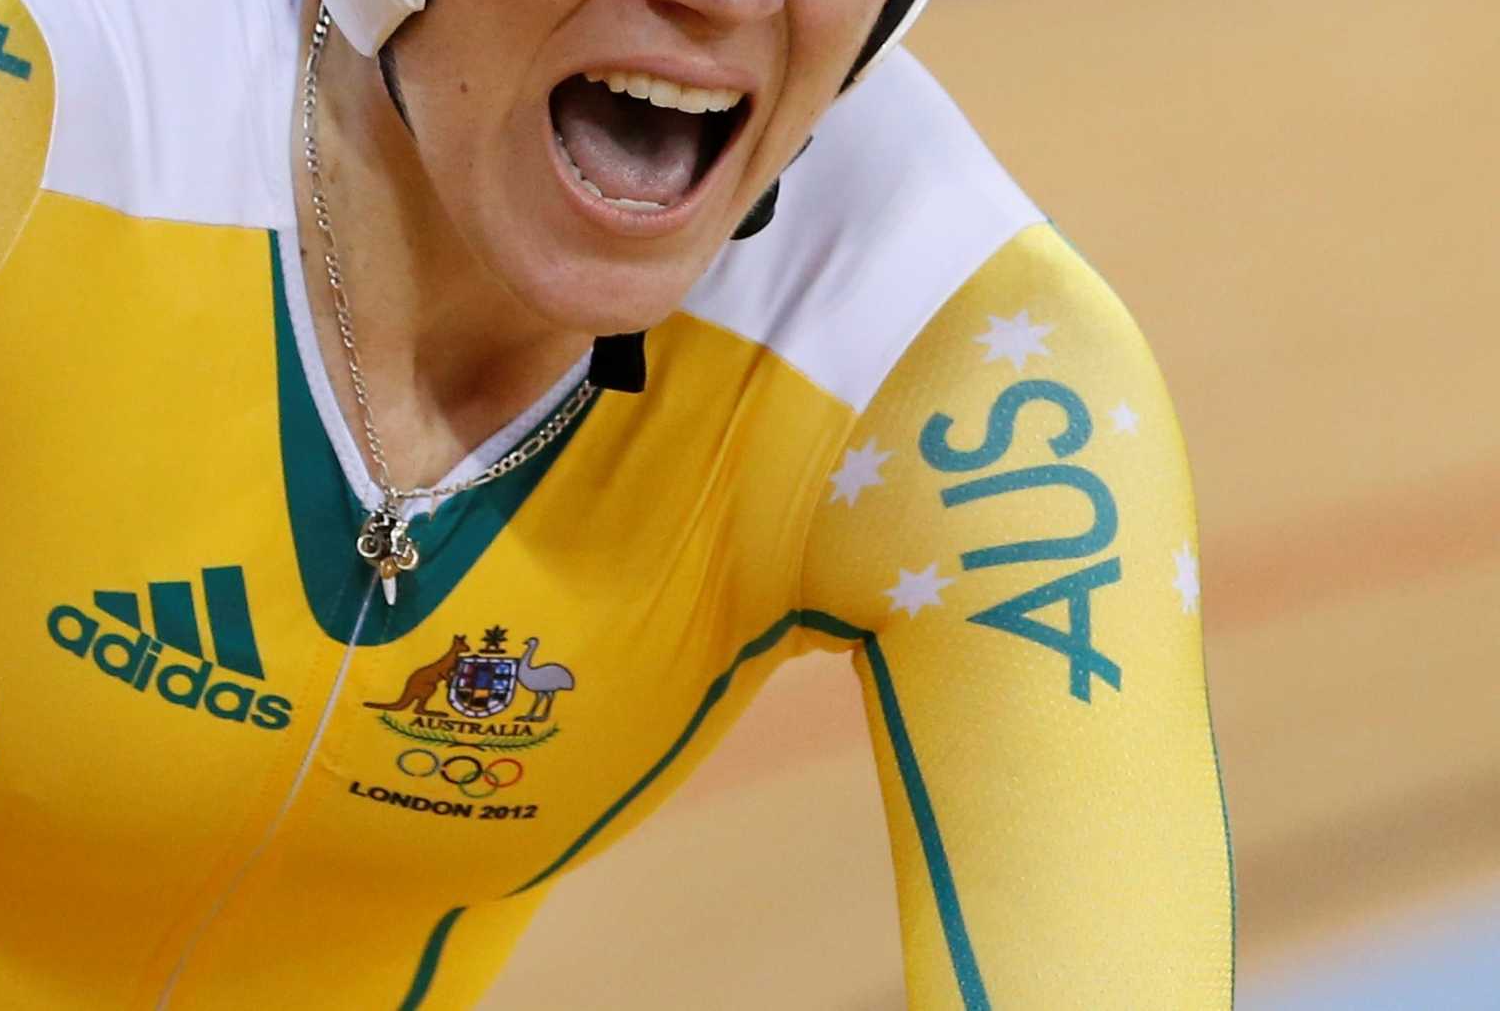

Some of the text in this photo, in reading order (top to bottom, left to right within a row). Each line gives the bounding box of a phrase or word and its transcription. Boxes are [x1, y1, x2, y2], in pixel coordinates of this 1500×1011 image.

[918, 379, 1122, 705] AUS
[47, 604, 293, 731] adidas
[411, 716, 533, 738] AUSTRALIA
[349, 781, 538, 820] LONDON 2012
